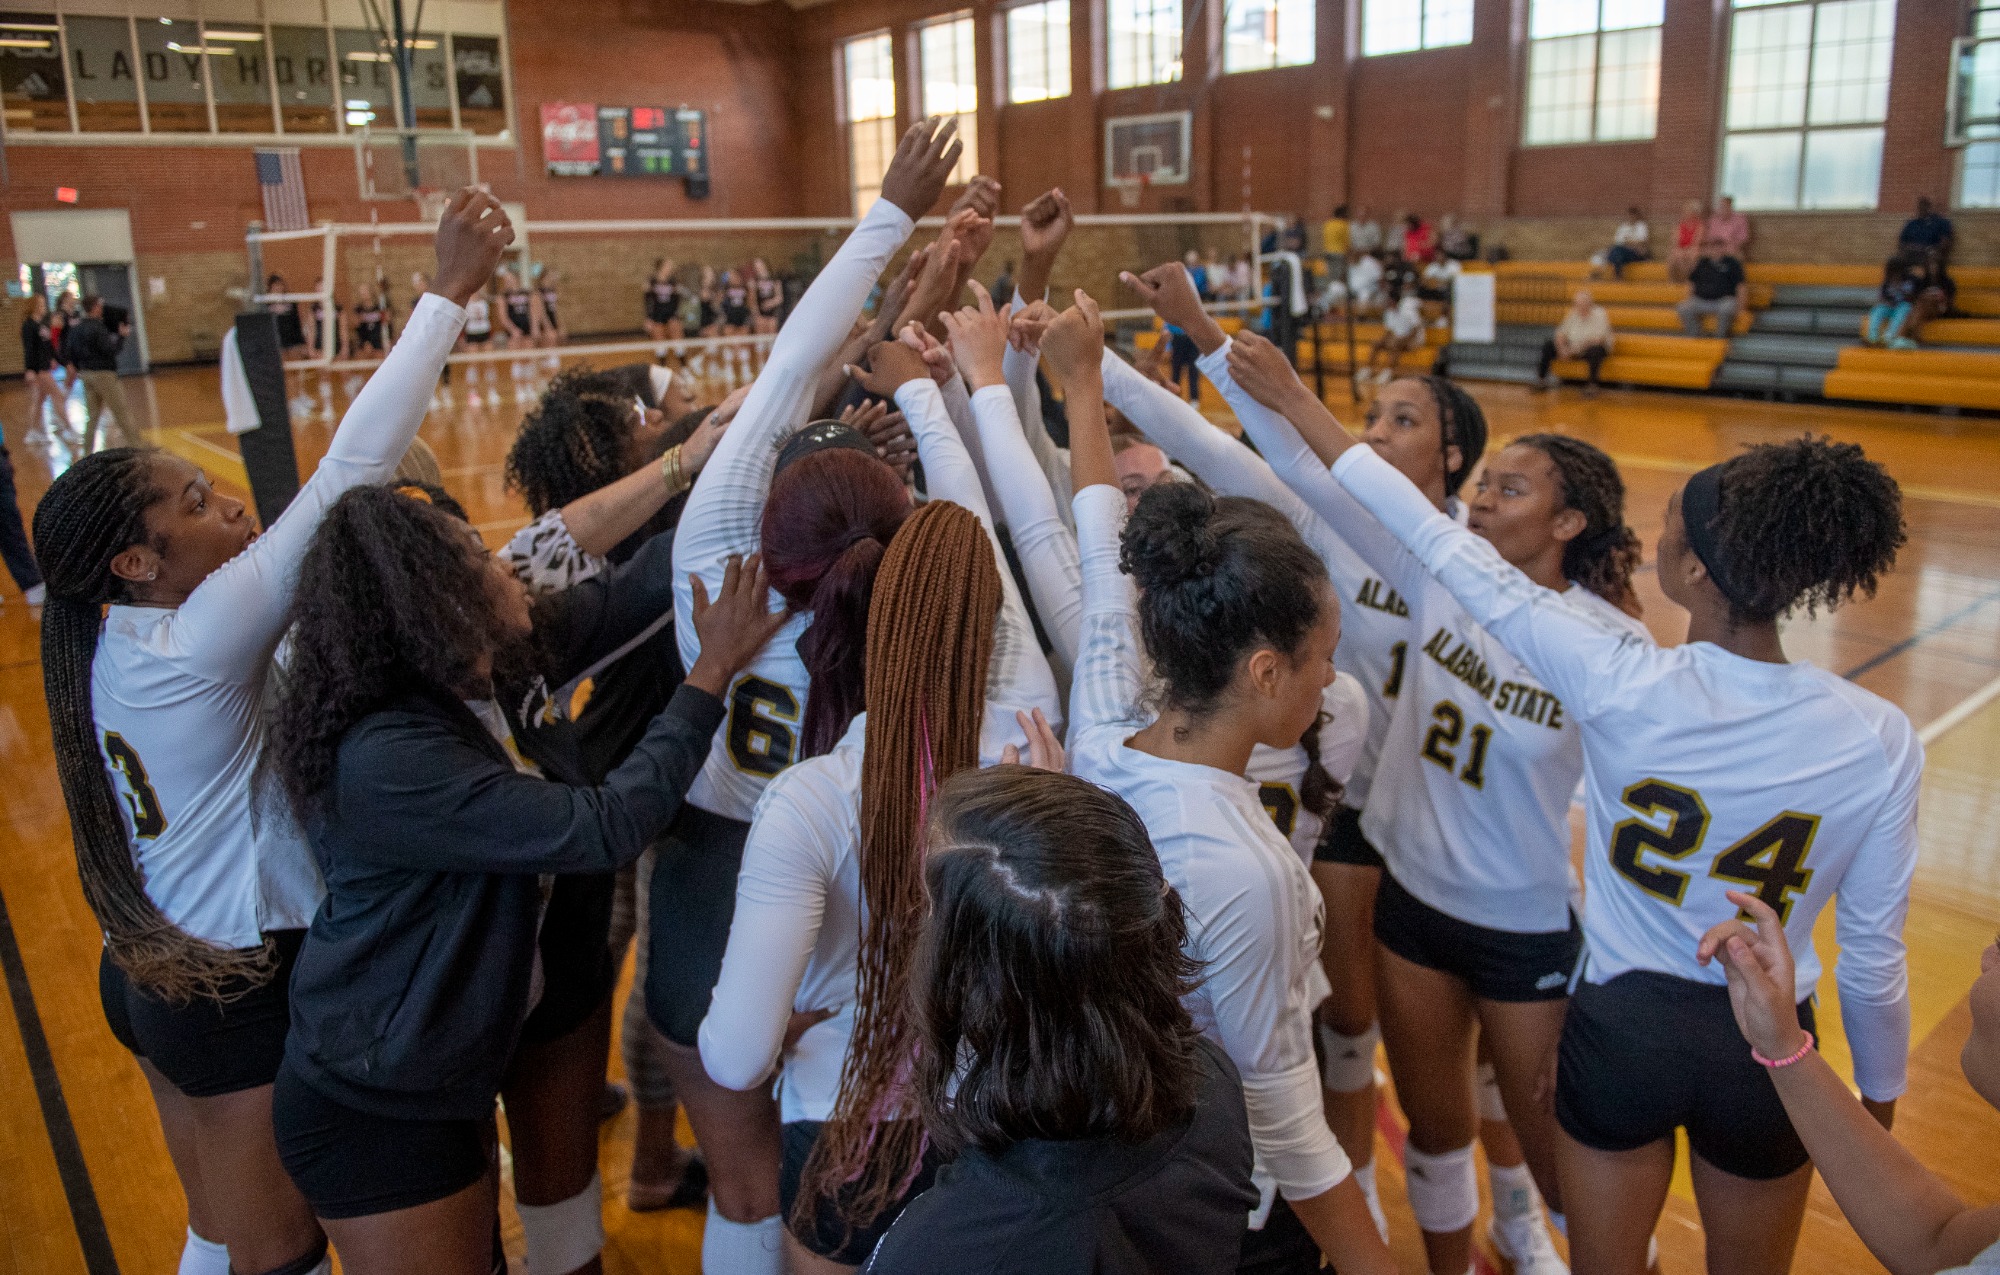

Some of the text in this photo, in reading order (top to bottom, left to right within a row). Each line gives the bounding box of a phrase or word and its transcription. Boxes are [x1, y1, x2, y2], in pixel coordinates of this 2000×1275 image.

[75, 48, 201, 82] LADY
[238, 56, 447, 92] HORNES
[726, 674, 800, 779] 6
[1420, 699, 1493, 791] 21
[1493, 681, 1564, 730] STATE
[103, 730, 168, 840] 3
[1608, 777, 1823, 928] 24
